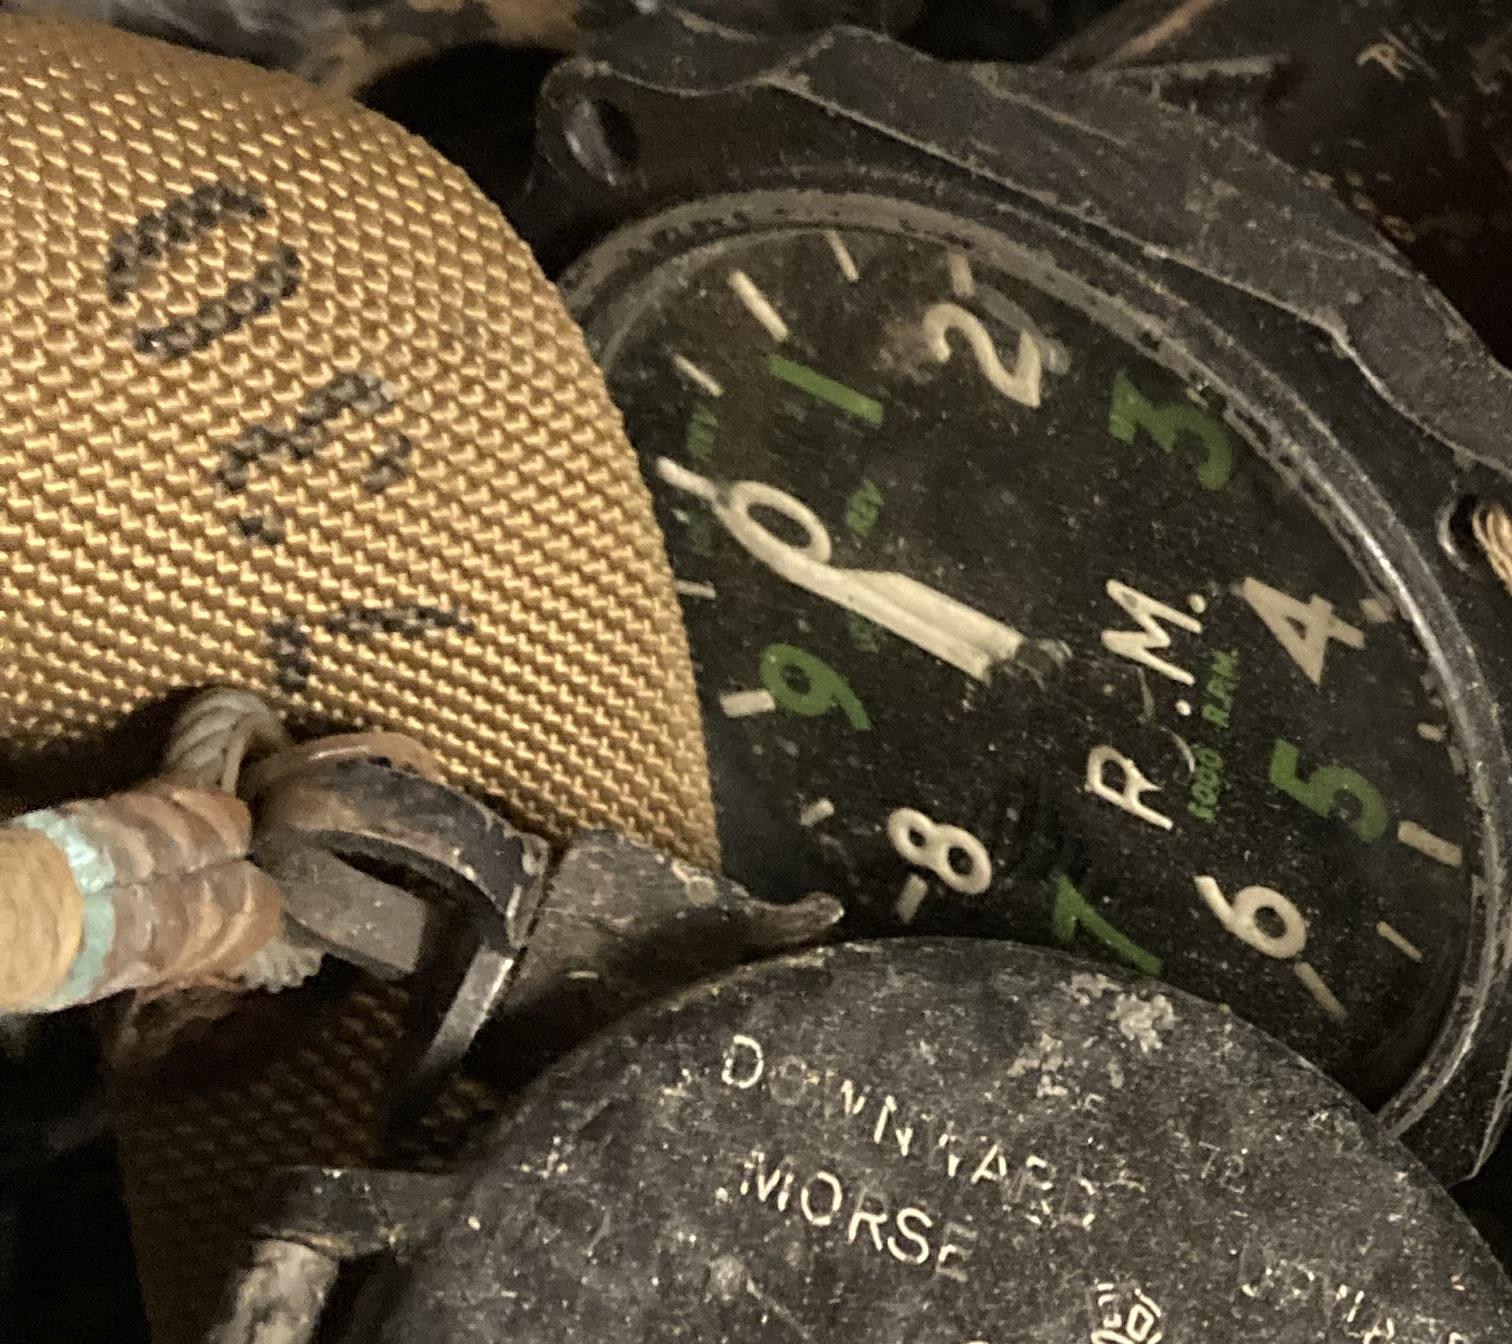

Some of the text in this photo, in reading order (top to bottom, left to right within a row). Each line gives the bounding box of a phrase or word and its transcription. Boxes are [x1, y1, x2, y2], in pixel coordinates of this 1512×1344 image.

[924, 303, 1041, 408] 2
[1108, 369, 1235, 490] 3
[1243, 576, 1367, 686] 4
[760, 643, 870, 731] 9
[1270, 739, 1388, 840] 5
[887, 806, 993, 895] 8
[1053, 873, 1162, 976] 7
[1194, 875, 1307, 959] 6
[733, 1151, 978, 1282] MORSE
